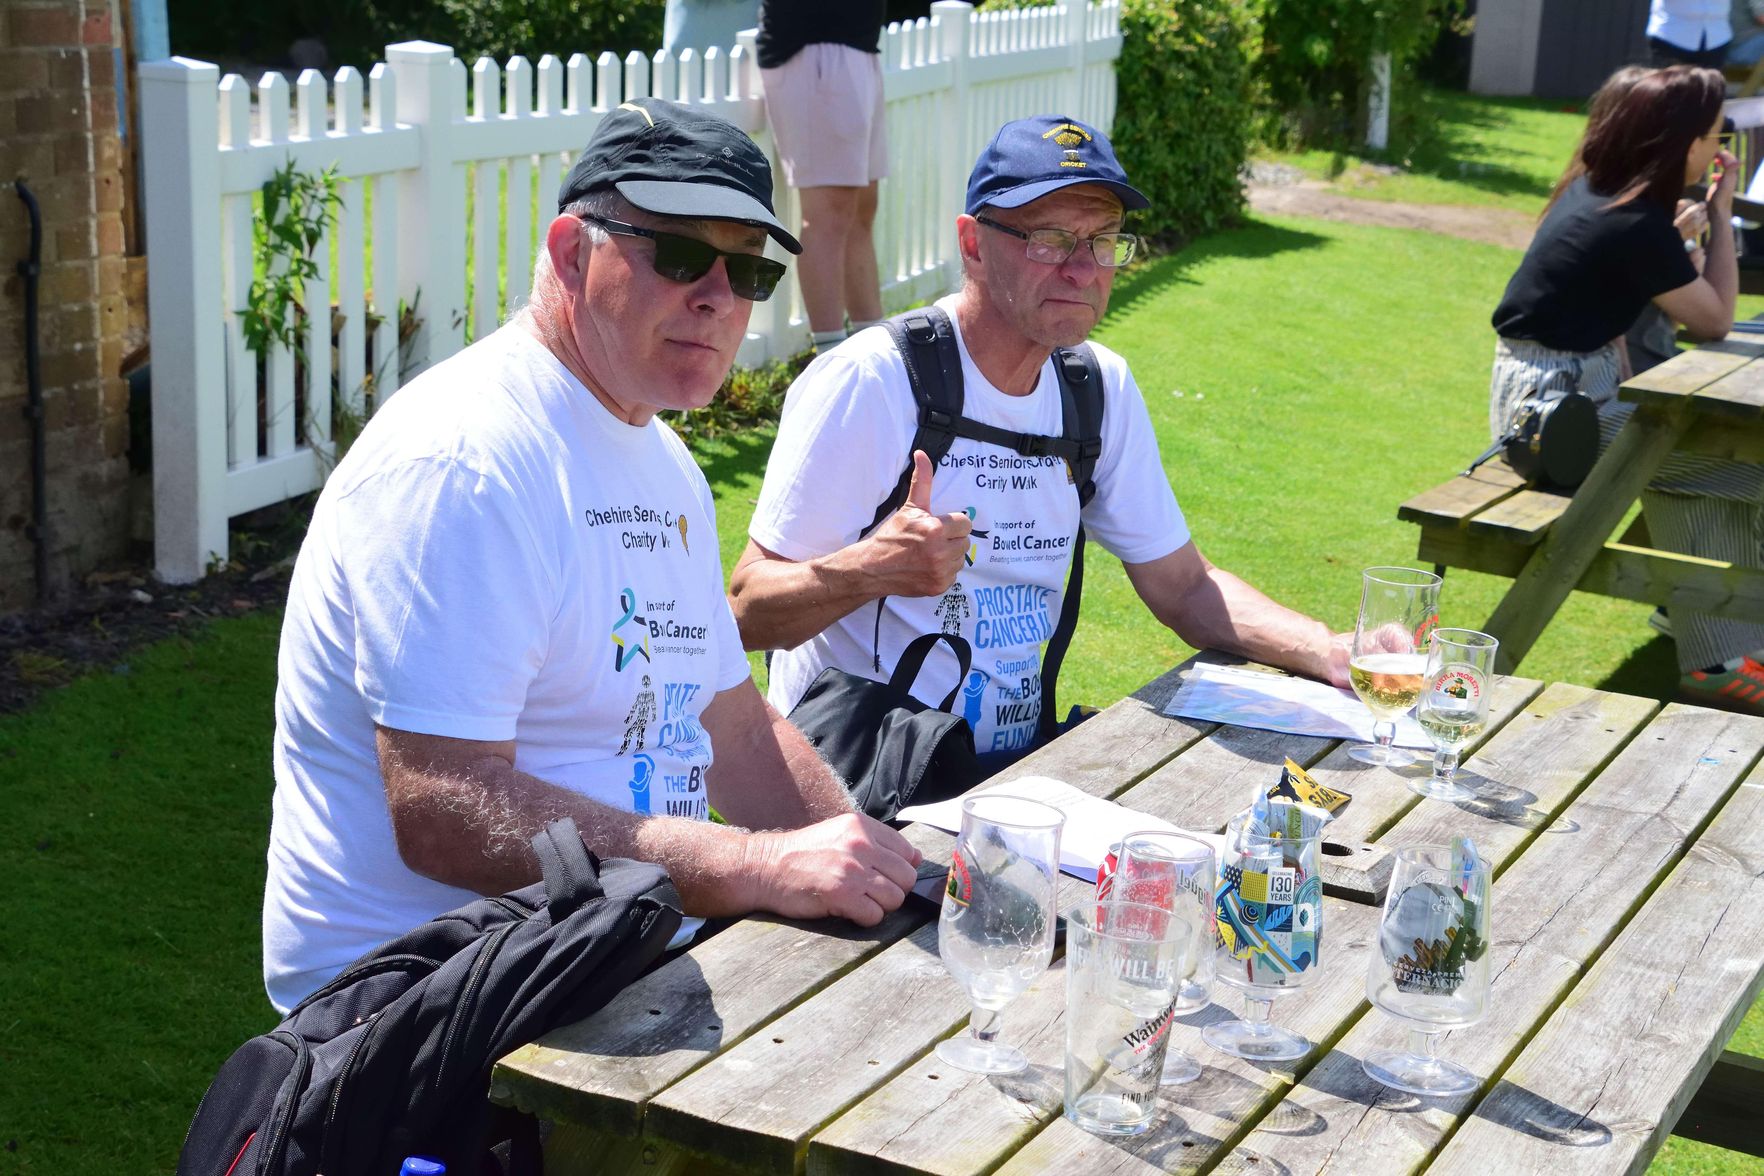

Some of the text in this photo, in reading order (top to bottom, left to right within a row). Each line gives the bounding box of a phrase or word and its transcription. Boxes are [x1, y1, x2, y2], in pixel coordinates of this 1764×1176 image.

[1024, 519, 1036, 529] of
[1023, 535, 1071, 550] Cancer
[1023, 554, 1044, 562] cancer
[646, 600, 655, 612] In
[666, 600, 676, 612] of
[974, 584, 1058, 618] PROSTATE
[665, 619, 707, 640] Cancer
[974, 614, 1042, 650] CANCER
[1435, 671, 1480, 698] BIRRA MORETTI
[997, 686, 1021, 700] THE
[664, 775, 687, 793] THE
[1270, 877, 1292, 893] 130
[1270, 892, 1292, 902] YEARS
[1121, 1092, 1141, 1104] FIND
